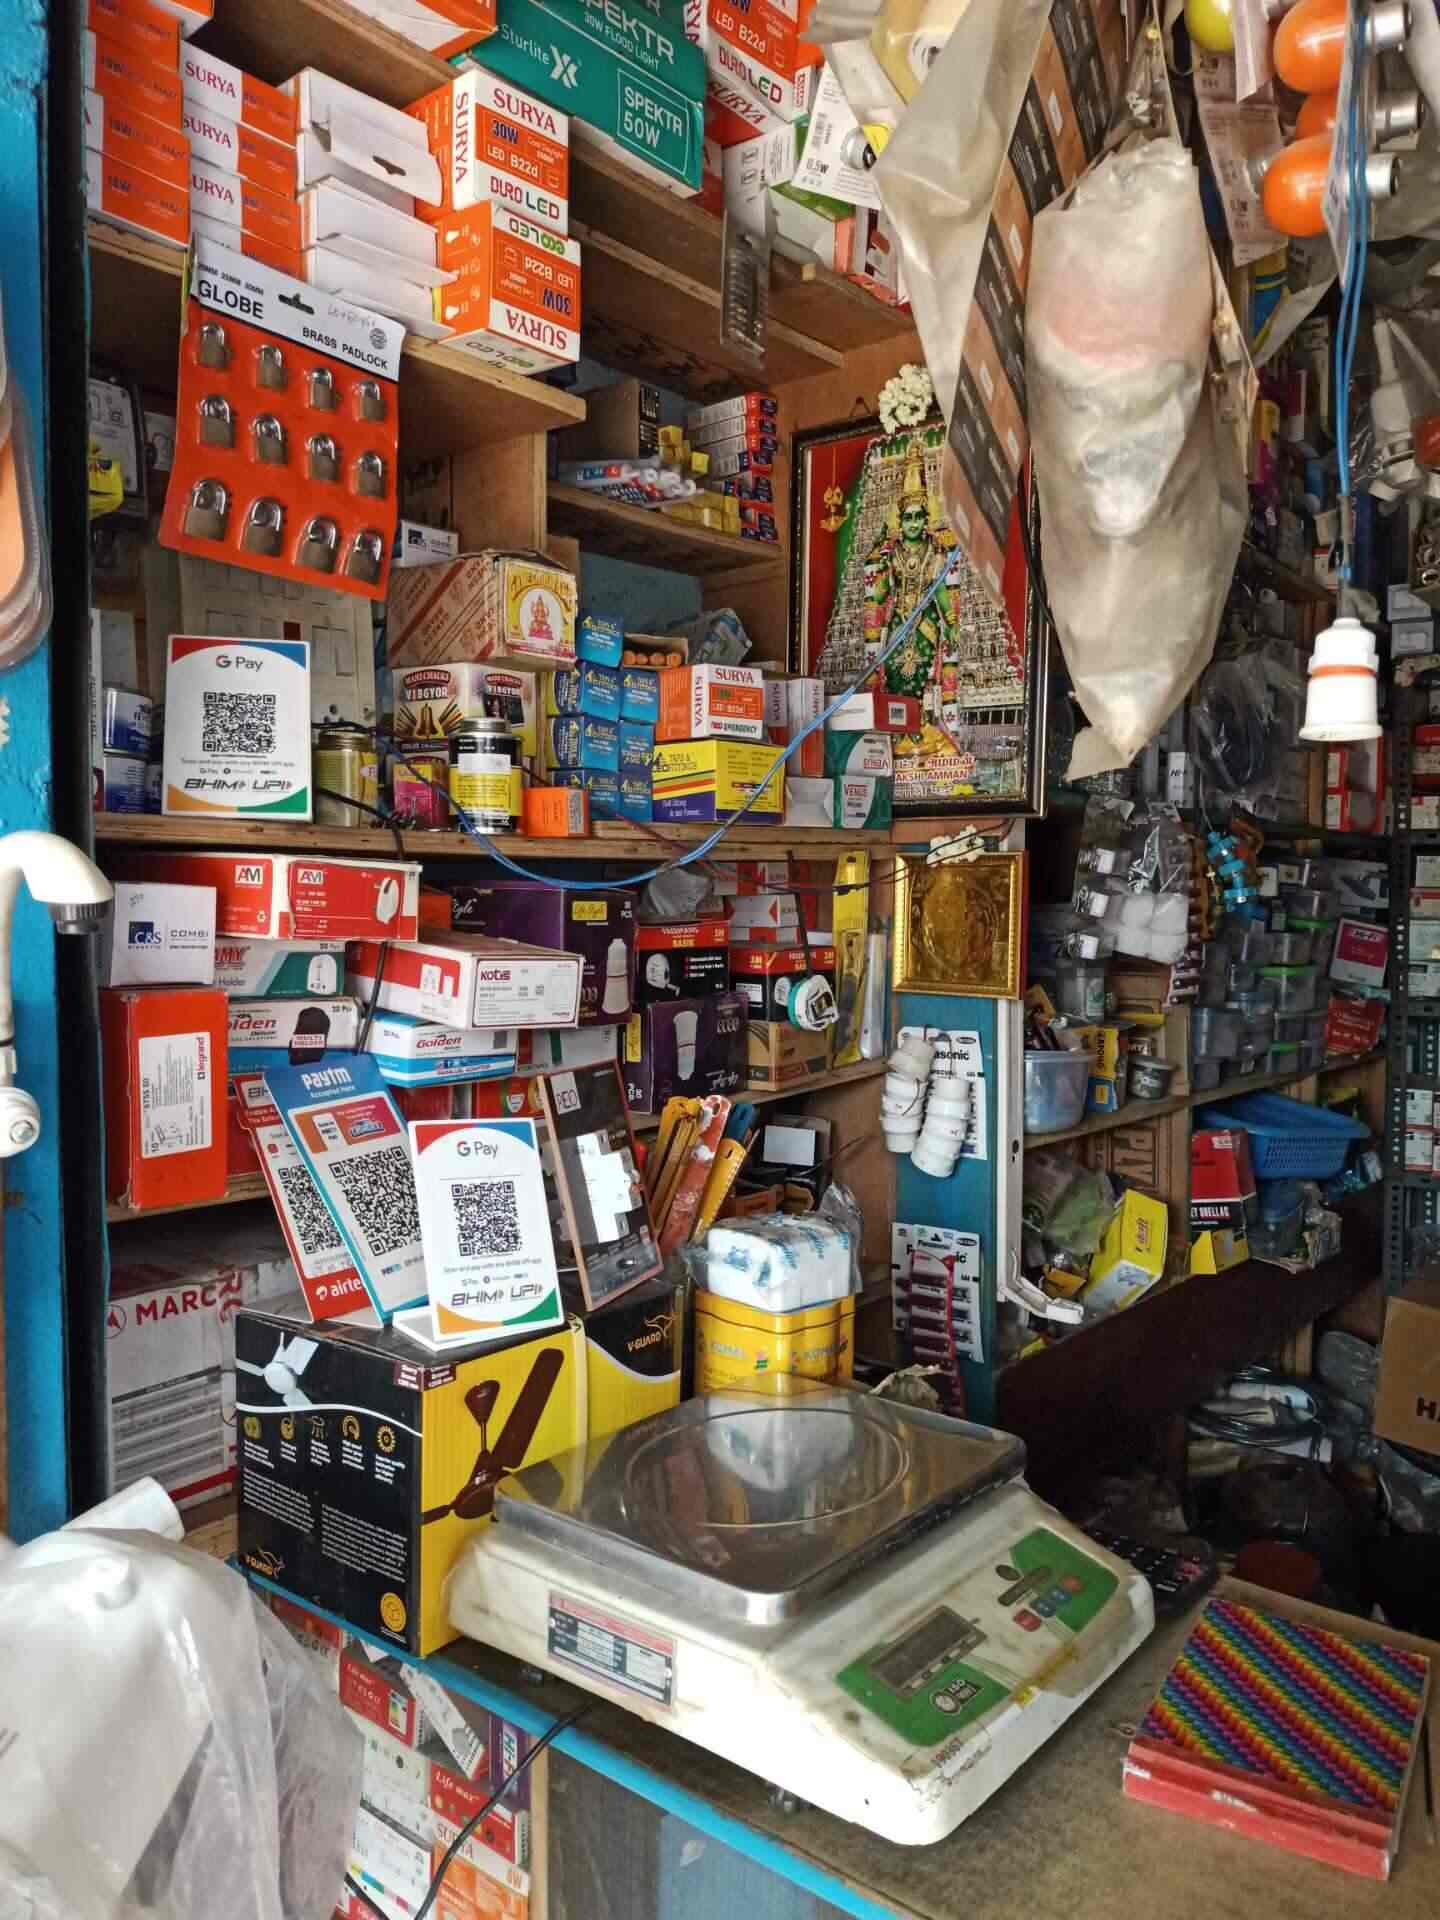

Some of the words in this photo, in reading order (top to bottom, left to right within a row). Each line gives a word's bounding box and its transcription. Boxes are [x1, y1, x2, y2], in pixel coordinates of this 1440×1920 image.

[502, 23, 550, 65] Sturlite
[605, 25, 633, 54] FLOOD
[635, 46, 659, 70] LIGHT
[715, 10, 733, 31] LED
[738, 24, 766, 54] B22d
[185, 60, 236, 98] SURYA
[747, 68, 783, 104] LED
[493, 88, 556, 134] SURYA
[623, 85, 683, 136] SPEKTR
[709, 80, 768, 126] SURYA
[184, 114, 232, 148] SURYA
[455, 91, 468, 184] SURYA
[492, 119, 519, 145] 30W
[623, 111, 660, 148] 50W
[487, 143, 505, 162] LED
[511, 153, 539, 178] B22d
[192, 174, 234, 204] URYA
[525, 190, 560, 221] LED
[524, 256, 553, 281] B22d
[557, 273, 574, 288] LED
[198, 279, 264, 320] GLOBE
[541, 287, 571, 315] 30W
[505, 309, 568, 350] SURYA
[302, 327, 337, 349] BRASS
[342, 343, 388, 370] PADLOCK
[216, 655, 231, 669] G
[235, 657, 263, 672] Pay
[715, 668, 753, 683] SURYA
[184, 778, 240, 789] BHIM
[252, 780, 286, 790] UPI
[237, 867, 261, 882] AM
[299, 871, 322, 884] AM
[135, 931, 162, 944] C&S
[416, 1034, 462, 1049] Golden
[934, 1049, 969, 1061] asonic
[456, 1141, 471, 1157] G
[474, 1141, 499, 1158] Pay
[330, 1277, 361, 1297] airte
[451, 1290, 498, 1306] BHIM
[511, 1284, 538, 1298] UPI
[627, 1332, 661, 1352] V-GUARD
